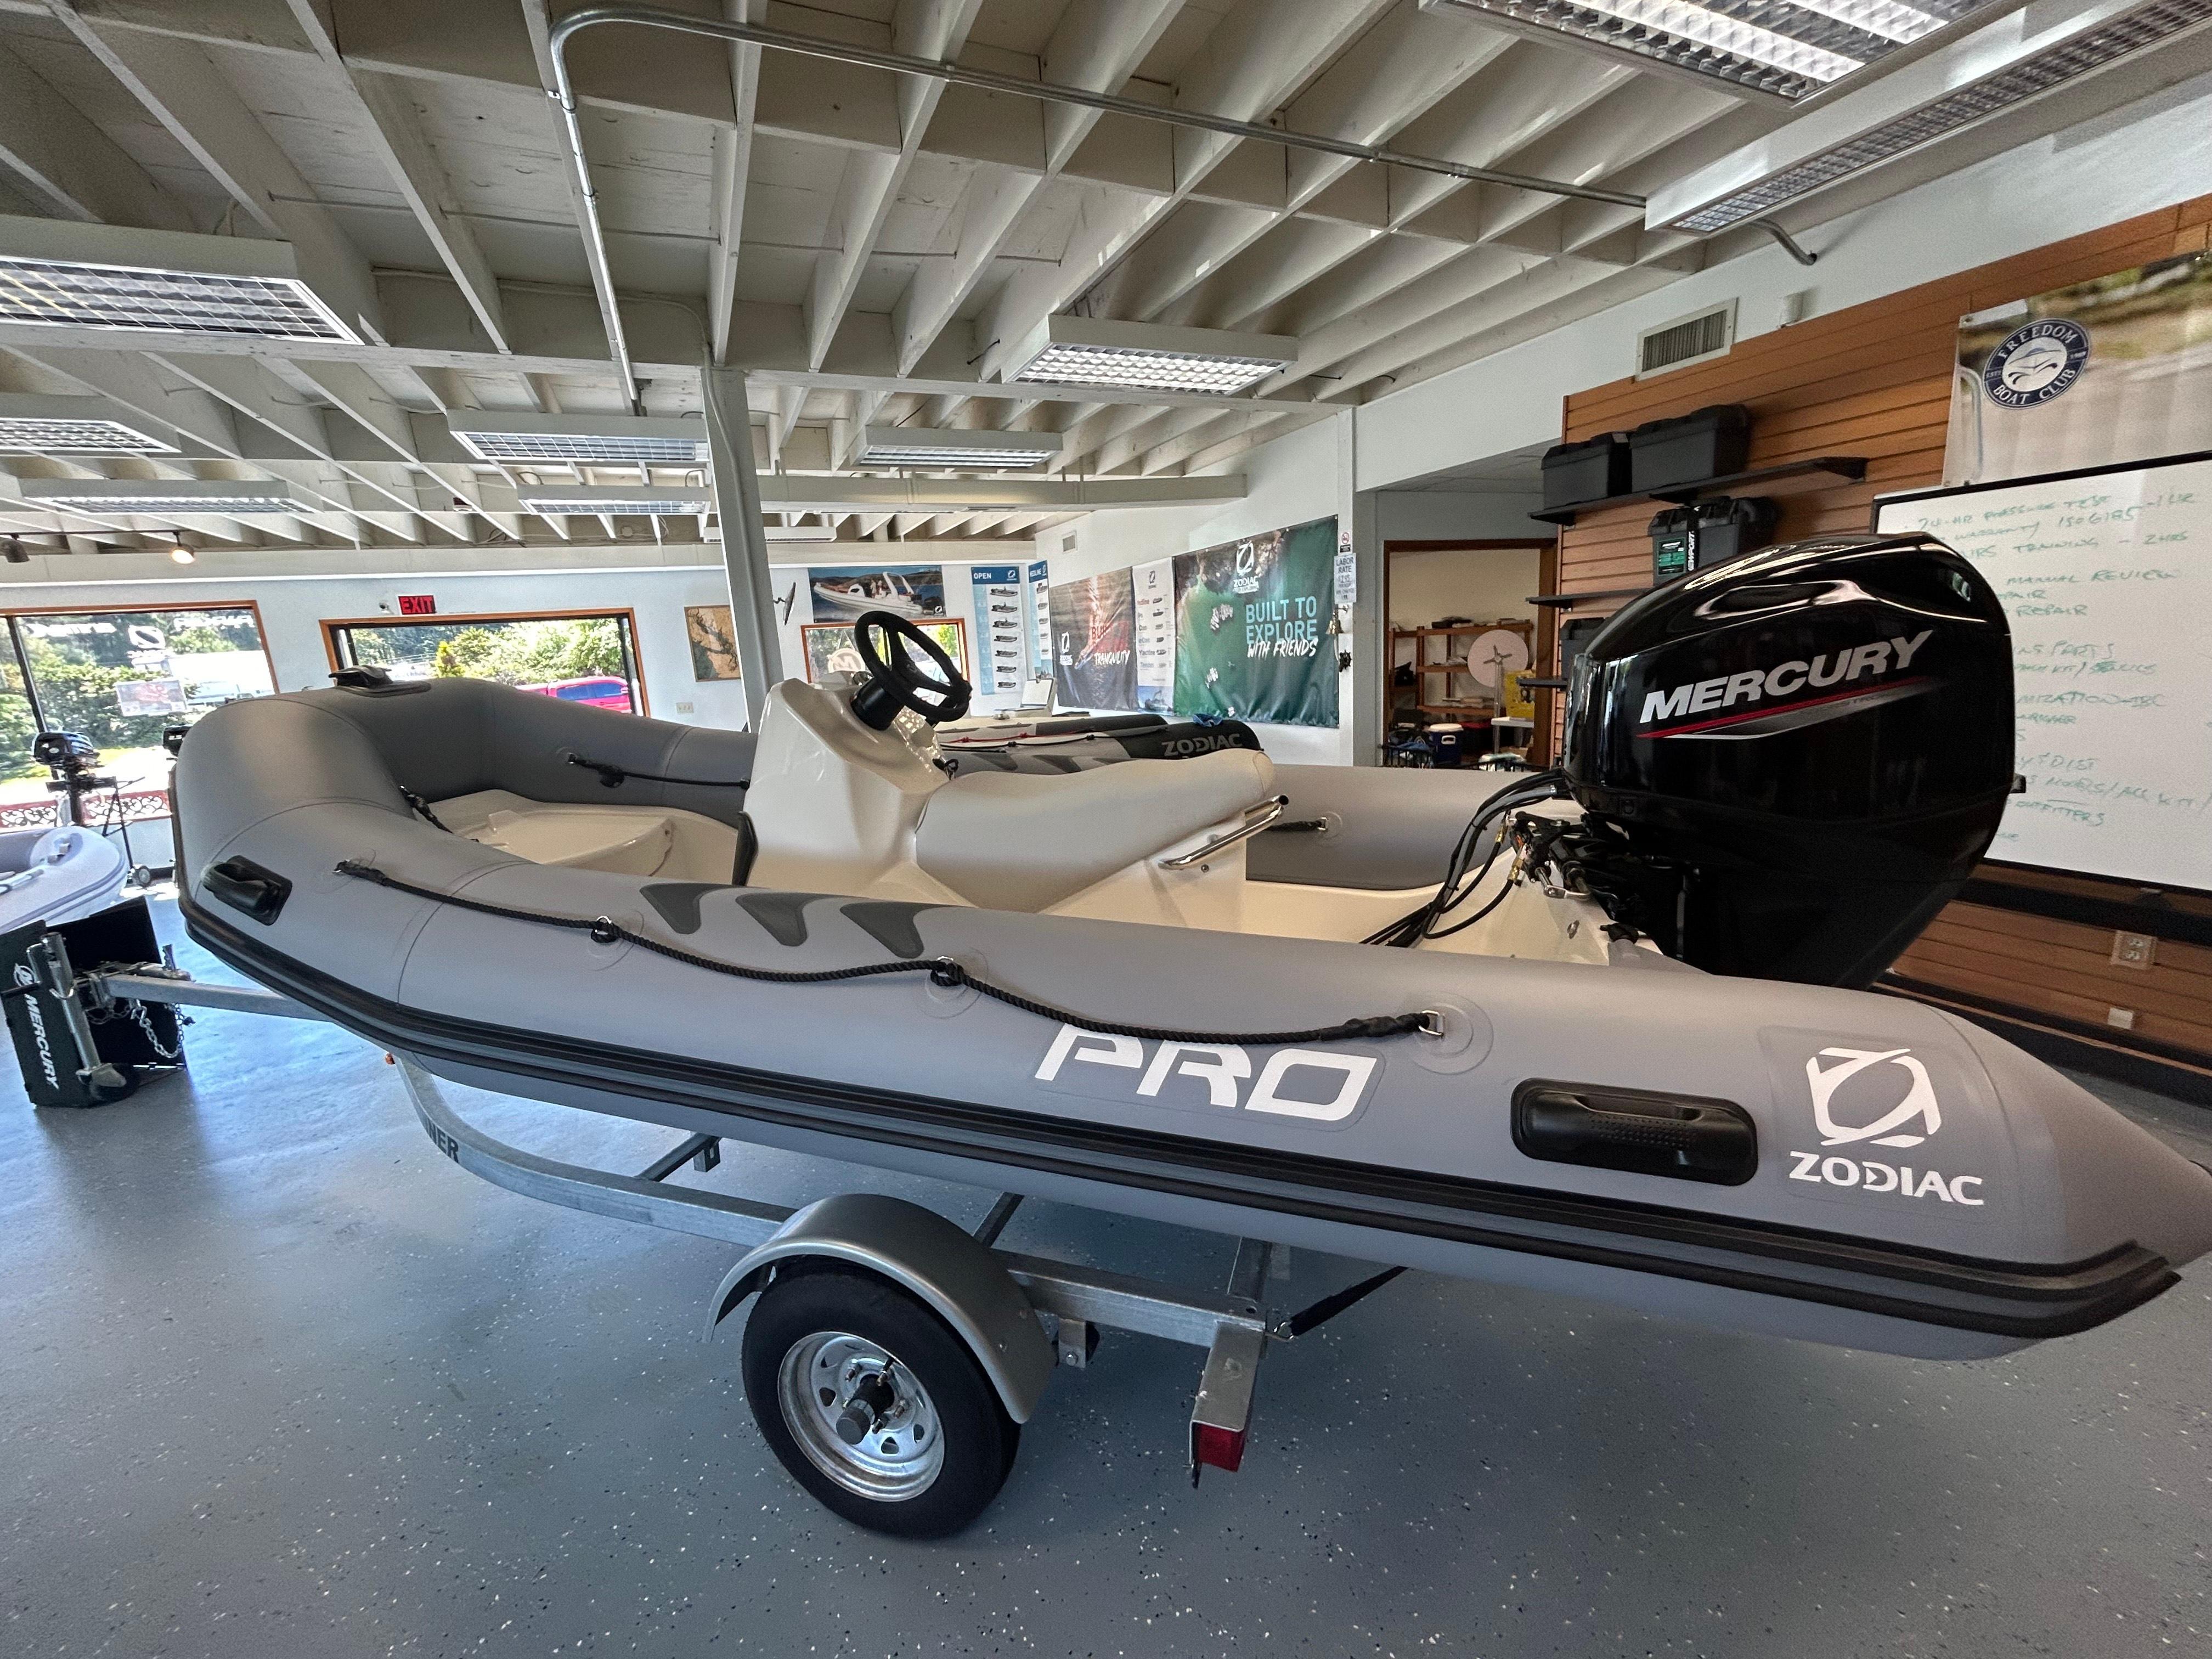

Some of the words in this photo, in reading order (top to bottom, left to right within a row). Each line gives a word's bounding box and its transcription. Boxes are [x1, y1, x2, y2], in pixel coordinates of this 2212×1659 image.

[1997, 325, 2078, 358] FREEDOM
[1993, 385, 2030, 404] BOAT
[2039, 369, 2076, 399] CLUB
[1336, 557, 1354, 566] LABOR
[1233, 576, 1259, 588] ZODIAC
[400, 596, 432, 613] EXIT
[1246, 599, 1289, 624] BUILT
[1295, 596, 1317, 619] TO
[1246, 619, 1317, 645] EXPLORE
[1094, 650, 1131, 667] TRANQUILITY
[1247, 641, 1271, 660] WITH
[1273, 635, 1319, 658] FRIENDS
[1640, 630, 1933, 724] MERCURY
[1161, 733, 1243, 757] ZODIAC
[24, 994, 59, 1090] MERCURY
[1035, 1023, 1377, 1121] PRO
[425, 1118, 459, 1164] NER
[1789, 1150, 1984, 1206] ZODIAC
